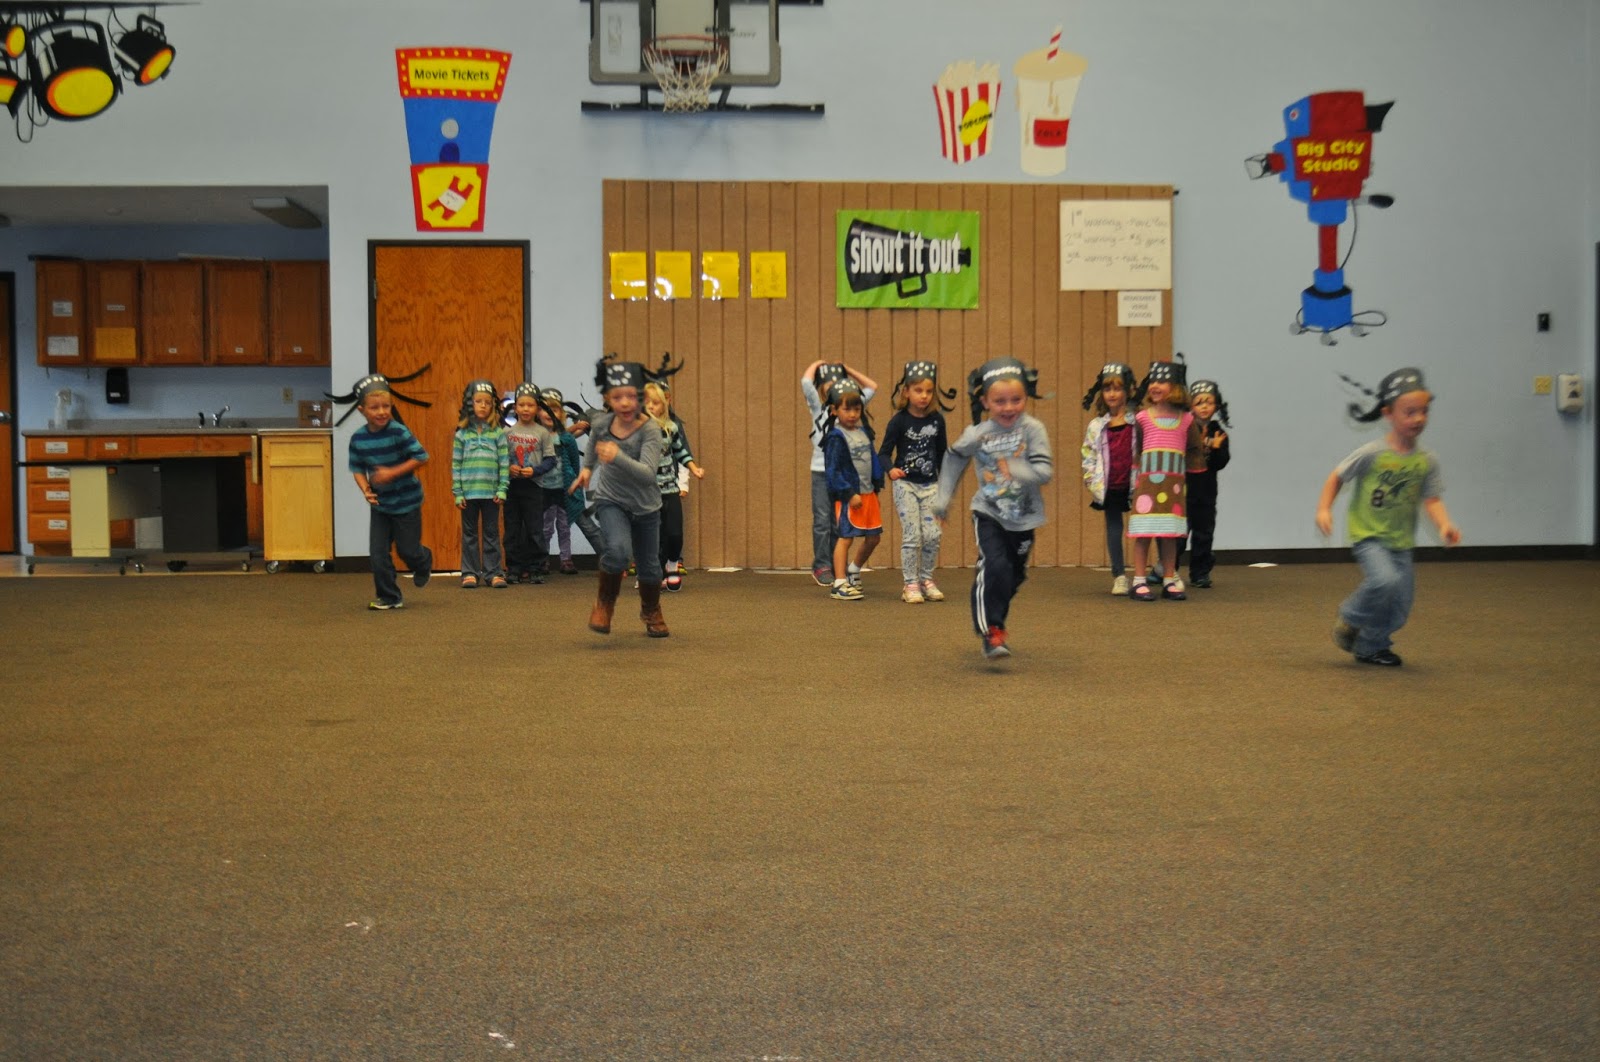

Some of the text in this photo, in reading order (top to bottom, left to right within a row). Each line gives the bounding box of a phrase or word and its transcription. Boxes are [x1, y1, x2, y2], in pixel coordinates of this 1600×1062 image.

[414, 68, 490, 80] Movie Tickets
[958, 112, 993, 132] POPCORN
[1297, 139, 1365, 157] Big City
[1302, 157, 1360, 174] Studio
[850, 230, 961, 274] shout it out
